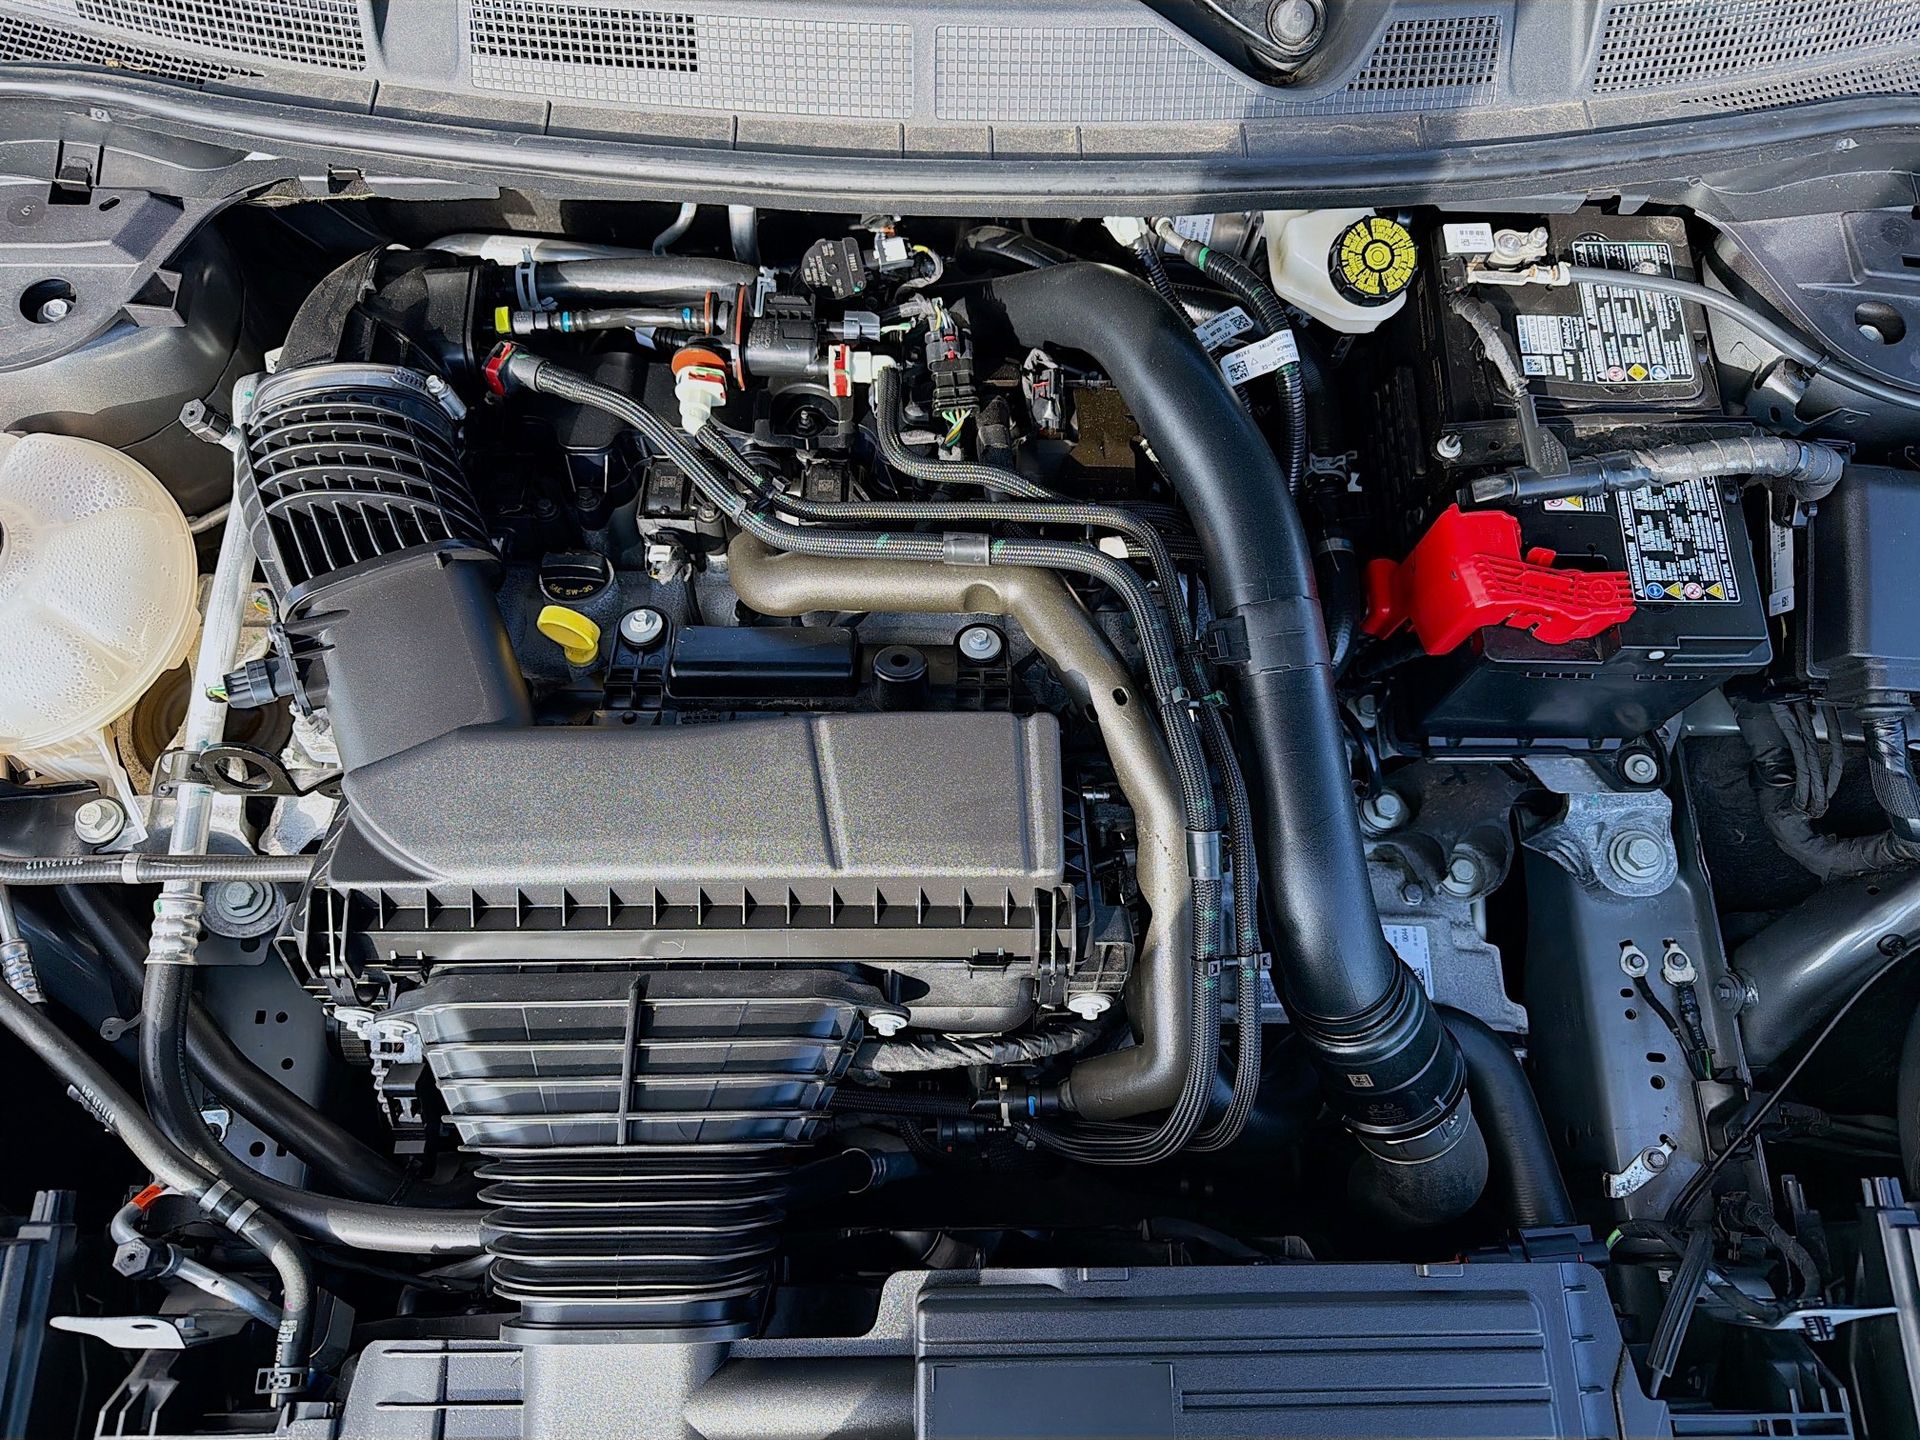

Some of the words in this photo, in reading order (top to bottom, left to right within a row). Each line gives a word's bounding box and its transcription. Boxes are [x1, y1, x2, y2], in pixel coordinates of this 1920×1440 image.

[1560, 317, 1572, 347] FoMoCo
[1717, 542, 1726, 552] PAS
[549, 583, 563, 594] SAE
[565, 584, 594, 596] 5W-30
[1724, 578, 1734, 589] NOT
